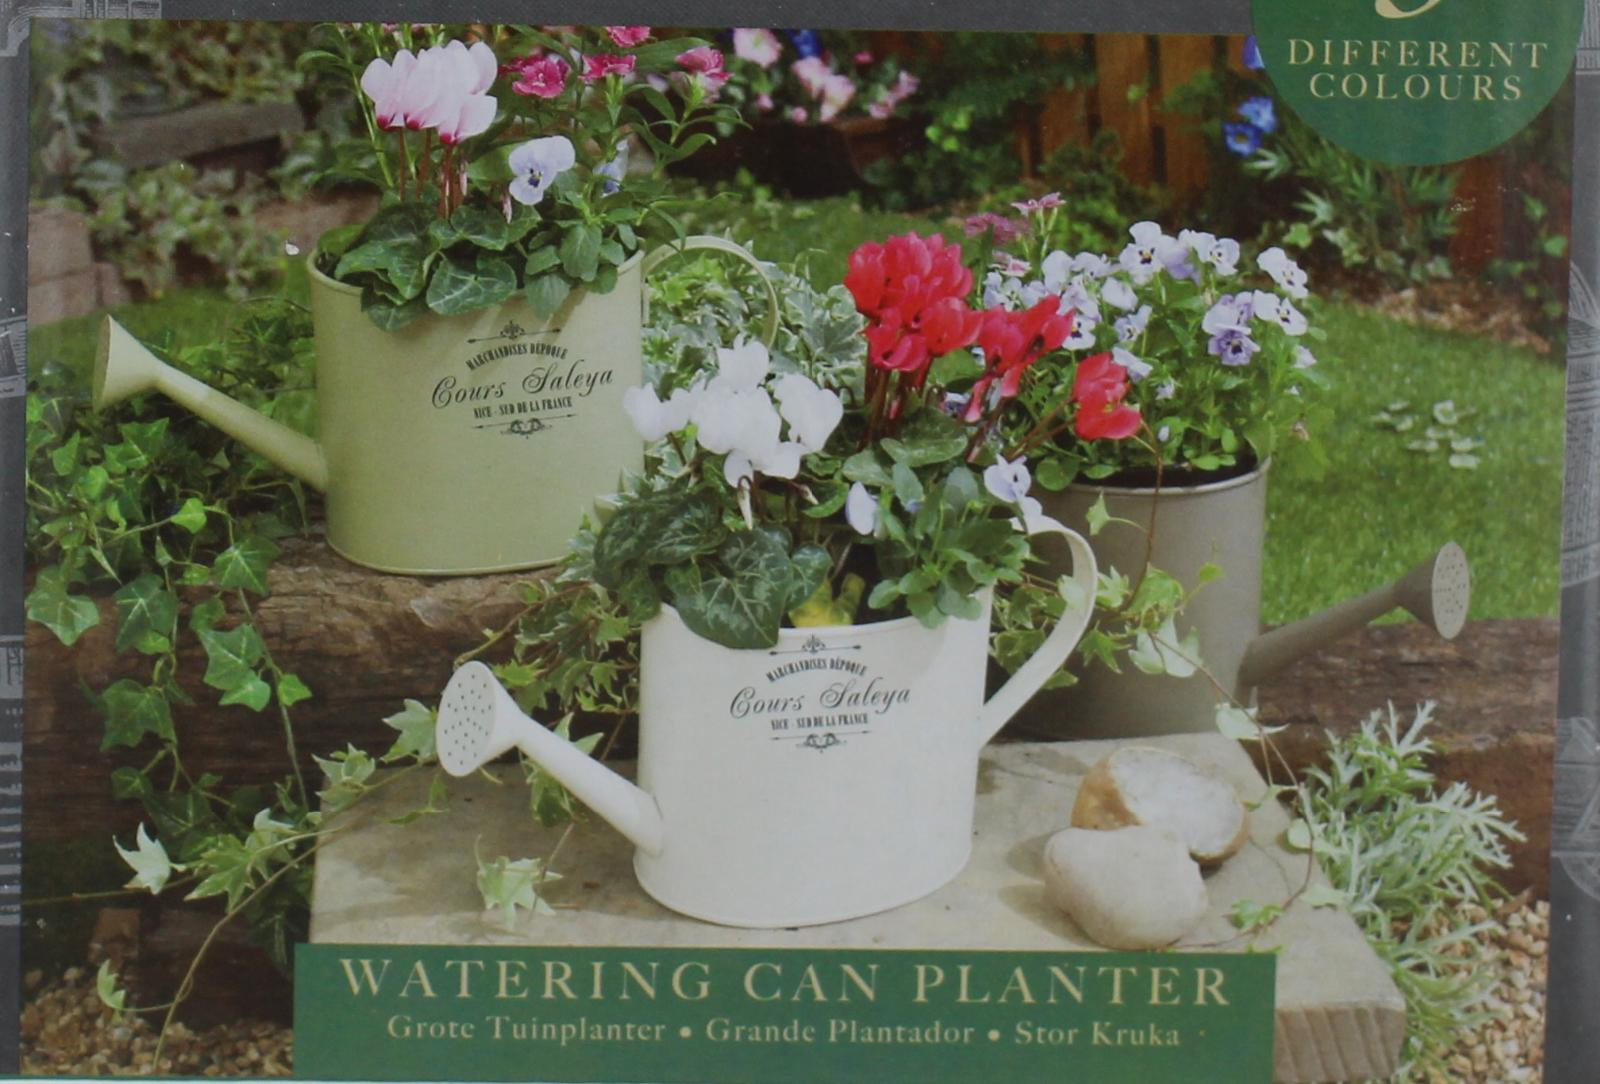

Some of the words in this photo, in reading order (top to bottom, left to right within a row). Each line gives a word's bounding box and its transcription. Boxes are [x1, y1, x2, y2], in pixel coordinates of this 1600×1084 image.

[1287, 38, 1548, 68] DIFFERENT
[1309, 72, 1522, 101] COLOURS
[432, 375, 507, 409] Cours
[521, 359, 614, 397] Saleya
[473, 406, 492, 419] NICE
[517, 401, 528, 414] DE
[530, 400, 541, 411] LA
[542, 396, 573, 410] FRANCE
[729, 686, 805, 719] Cours
[819, 676, 911, 715] Saleya
[838, 713, 869, 726] FRANCE
[339, 958, 712, 1001] WATERING
[743, 962, 880, 1003] CAN
[913, 964, 1231, 1007] PLANTER
[387, 1014, 475, 1040] Grote
[486, 1015, 666, 1047] Tuinplanter
[706, 1017, 816, 1043] Grande
[828, 1019, 975, 1046] Plantador
[1014, 1020, 1079, 1047] Stor
[1091, 1021, 1181, 1048] Kruka
